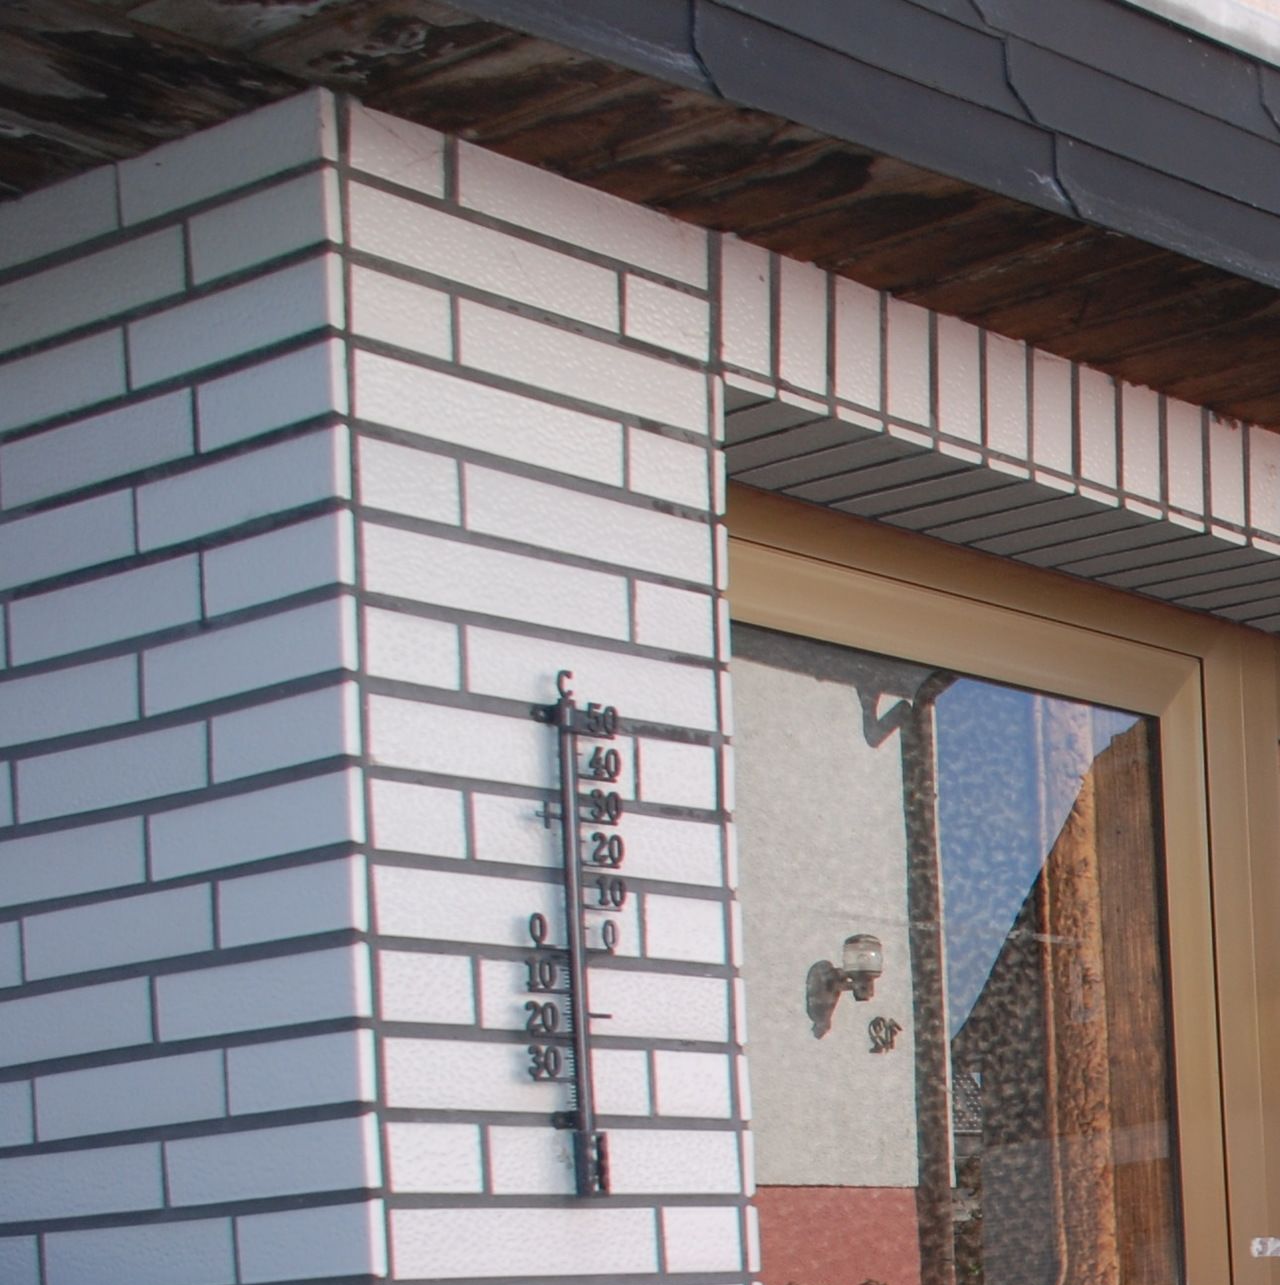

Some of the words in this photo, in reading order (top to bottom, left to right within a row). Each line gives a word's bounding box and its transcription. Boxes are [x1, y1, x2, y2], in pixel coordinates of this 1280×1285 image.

[557, 670, 573, 698] C
[587, 702, 618, 735] 50
[589, 746, 621, 779] 40
[590, 789, 622, 821] 30
[591, 831, 624, 865] 20
[596, 876, 626, 907] 10
[529, 912, 547, 944] 0
[602, 919, 619, 949] 0
[525, 956, 557, 991] 10
[525, 1000, 560, 1034] 20
[528, 1044, 562, 1078] 30
